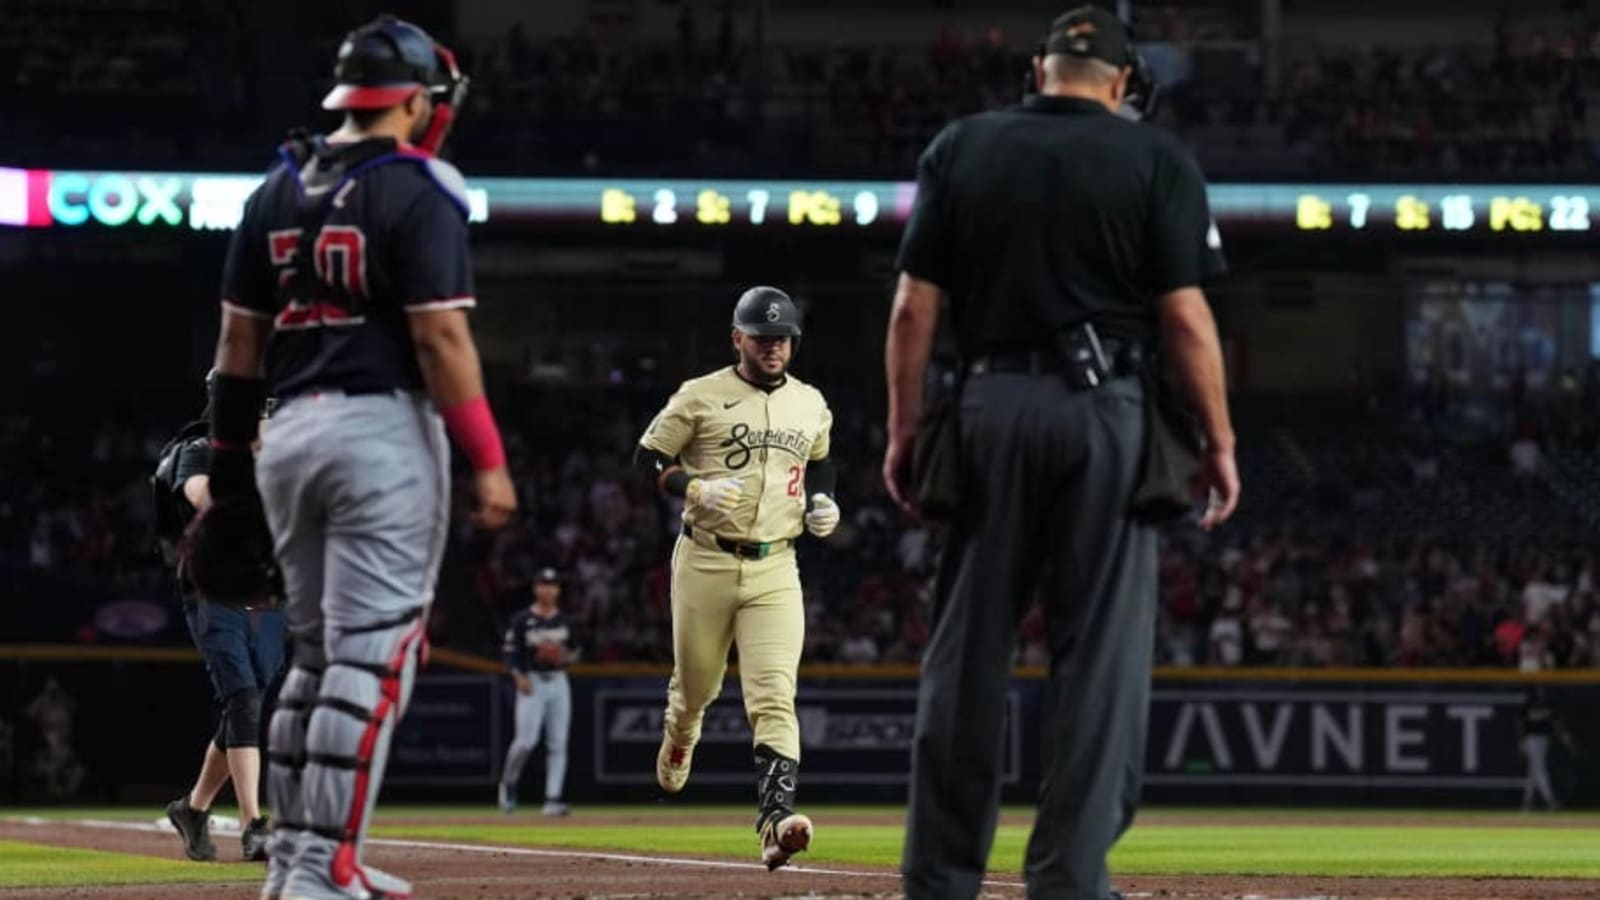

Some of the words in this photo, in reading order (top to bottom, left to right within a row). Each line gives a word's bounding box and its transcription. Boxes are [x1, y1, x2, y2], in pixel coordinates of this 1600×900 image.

[48, 174, 184, 226] COX
[653, 189, 677, 224] 2
[697, 190, 730, 224] S:
[747, 189, 769, 224] 7
[788, 191, 841, 225] PC:
[854, 191, 878, 225] 9
[1347, 193, 1370, 228] 7
[1395, 195, 1430, 229] S:
[1440, 195, 1475, 230] 15
[1490, 197, 1543, 231] PC:
[1549, 196, 1590, 230] 22
[268, 225, 367, 329] 20
[1164, 703, 1495, 771] AVNET
